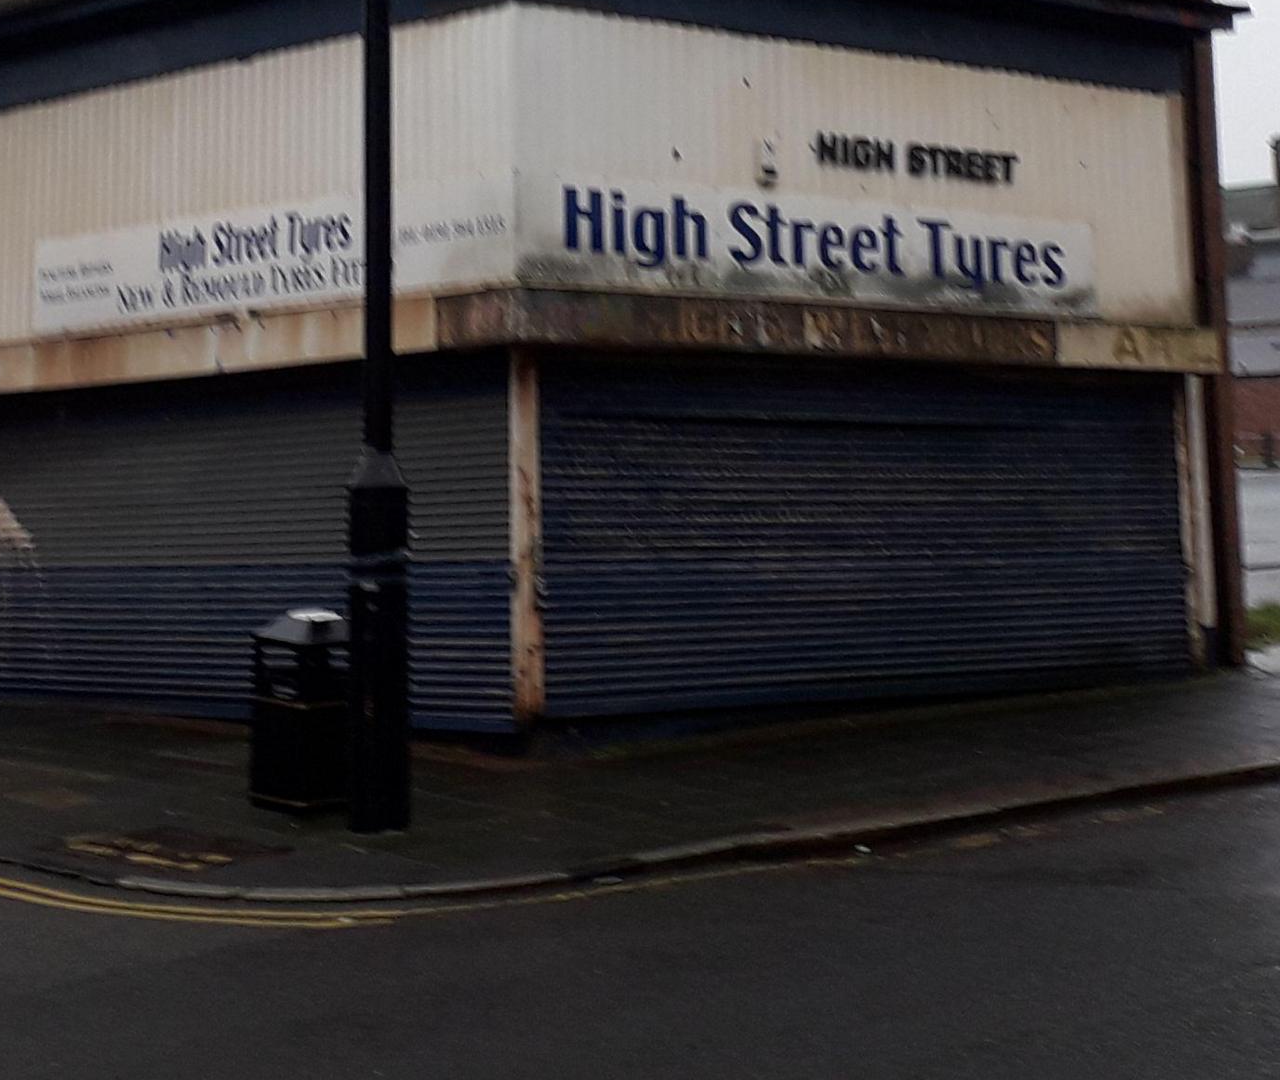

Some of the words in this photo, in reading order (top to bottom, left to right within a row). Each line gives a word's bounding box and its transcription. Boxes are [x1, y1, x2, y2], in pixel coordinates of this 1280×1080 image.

[816, 131, 894, 171] HIGH
[907, 142, 1018, 185] STREET
[158, 225, 208, 273] High
[212, 217, 280, 268] Street
[286, 210, 353, 262] Tyres
[562, 185, 708, 268] High
[727, 200, 904, 277] Street
[917, 217, 1066, 291] Tyres
